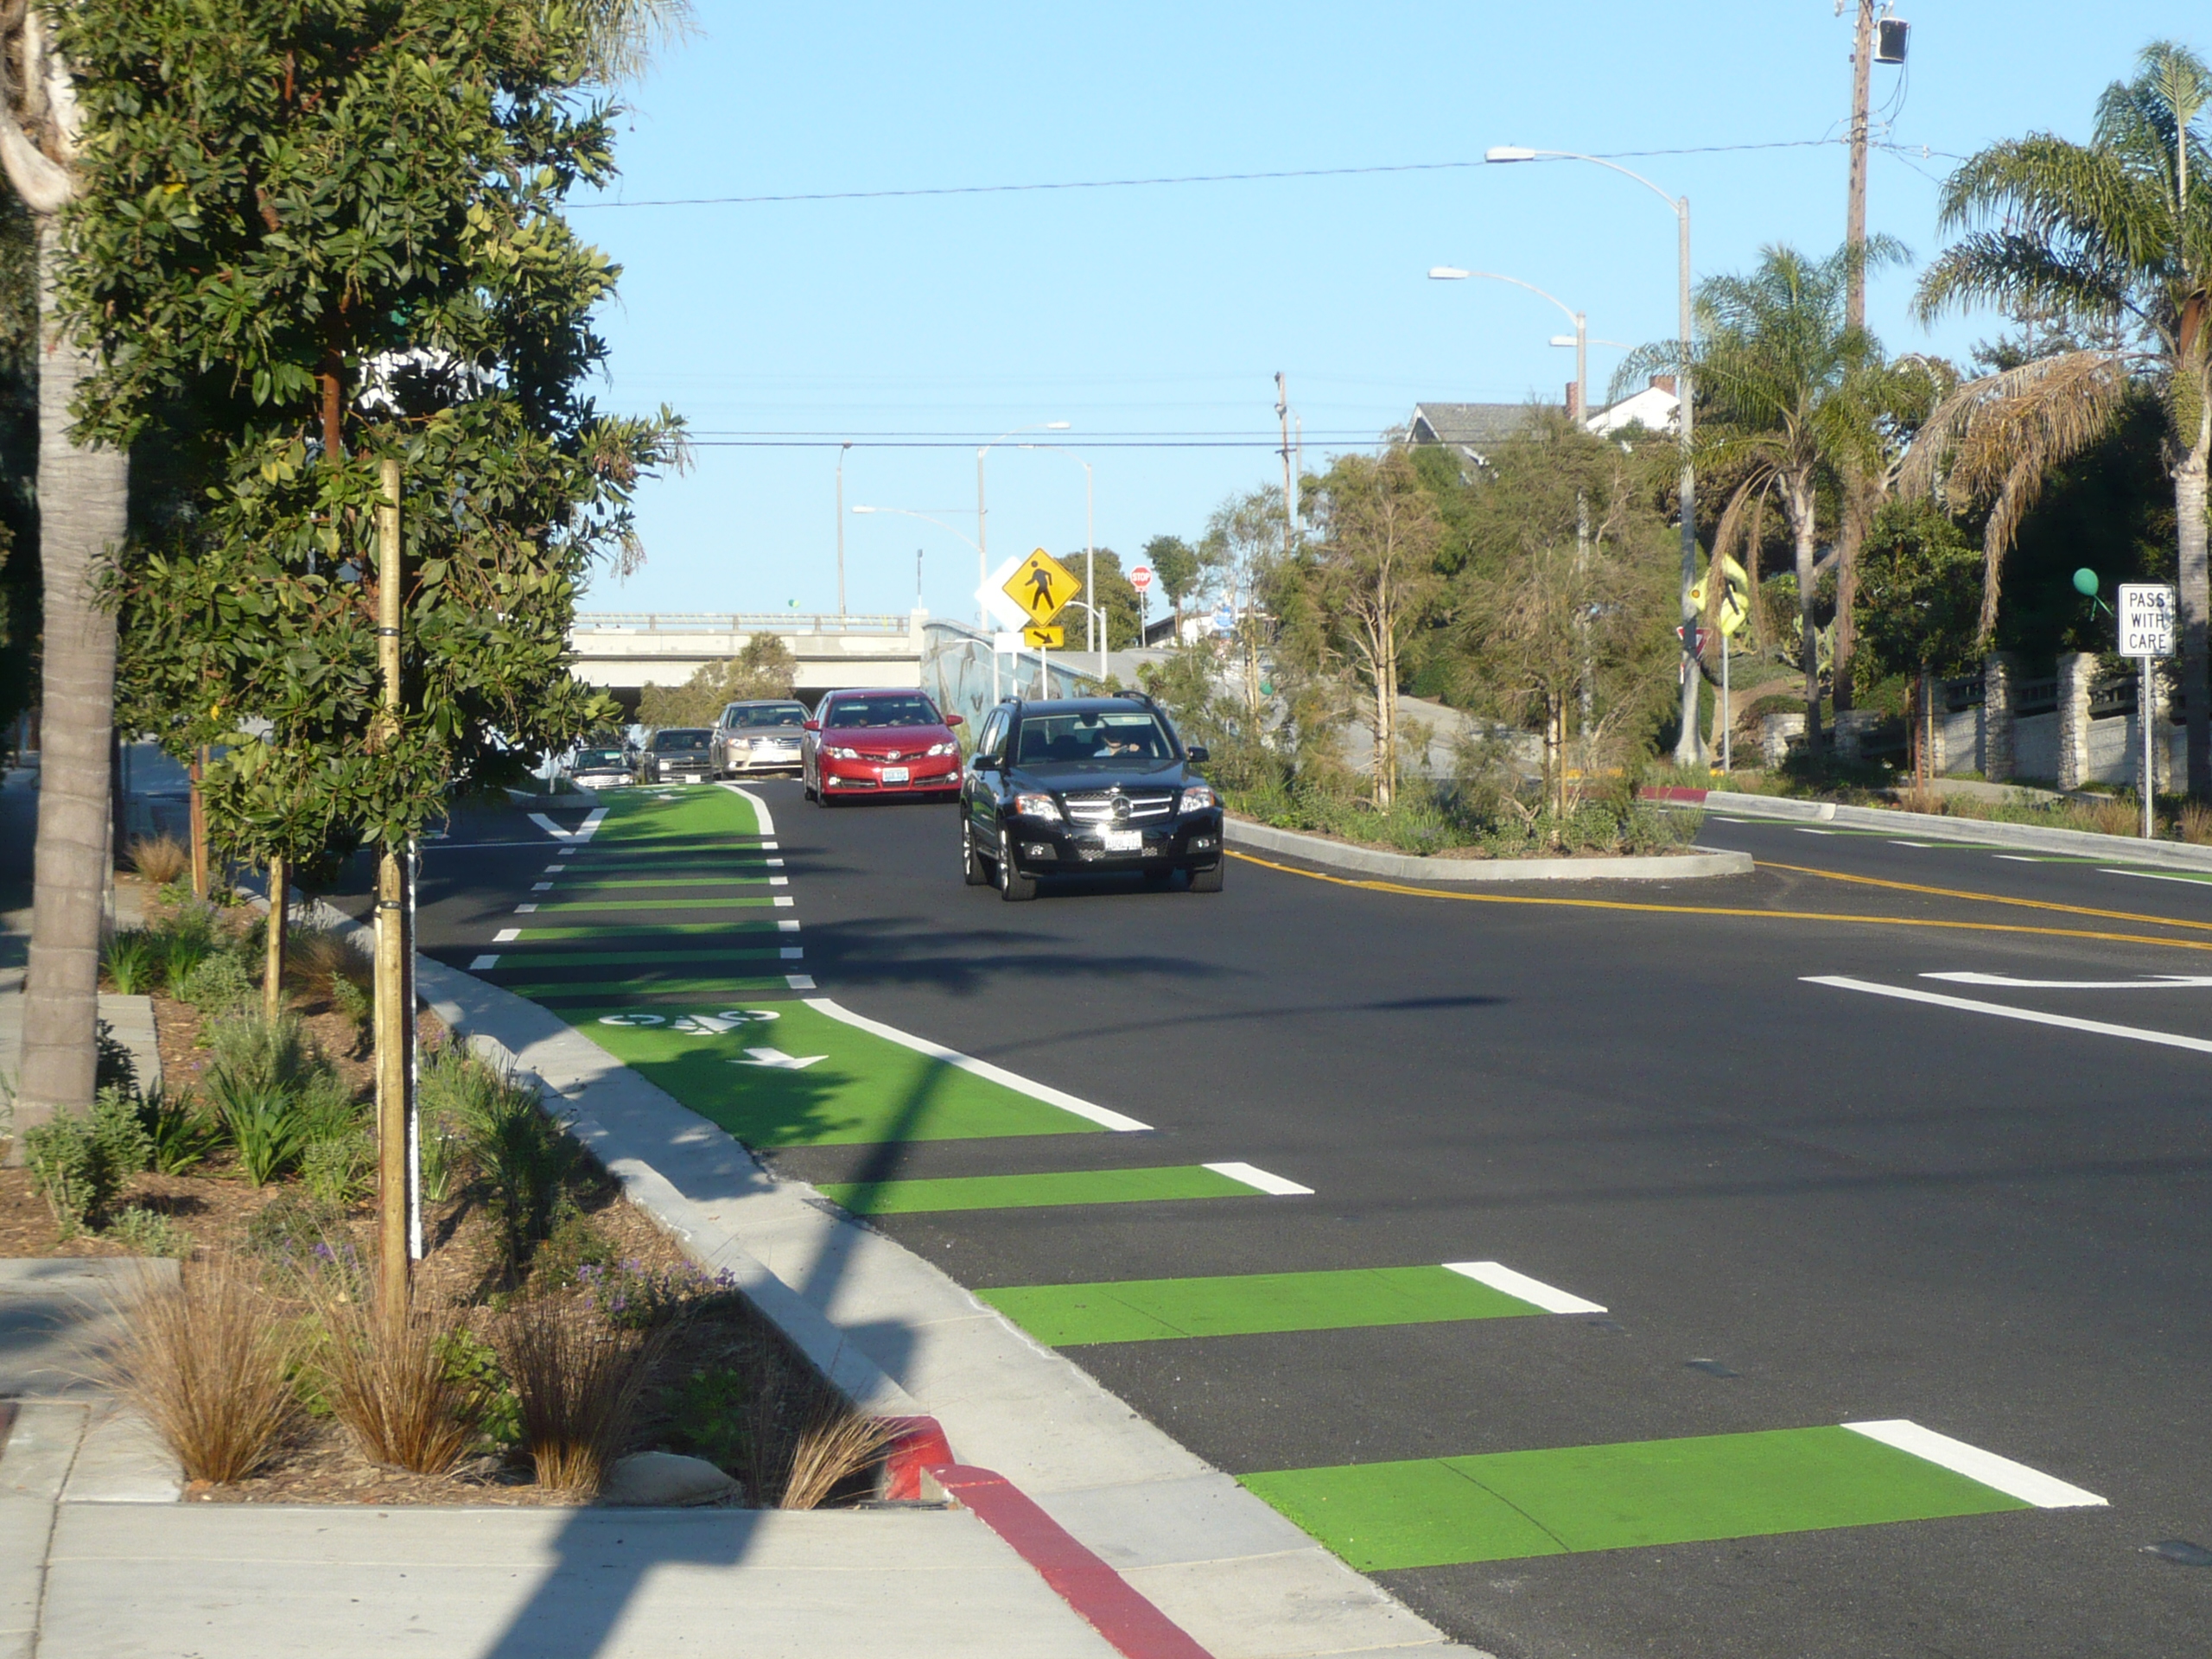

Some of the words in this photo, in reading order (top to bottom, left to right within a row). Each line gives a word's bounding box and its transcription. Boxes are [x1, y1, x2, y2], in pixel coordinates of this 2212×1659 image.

[1132, 572, 1151, 582] STOP
[2129, 592, 2165, 607] PASS
[2131, 613, 2164, 628] WITH
[2129, 633, 2167, 649] CARE
